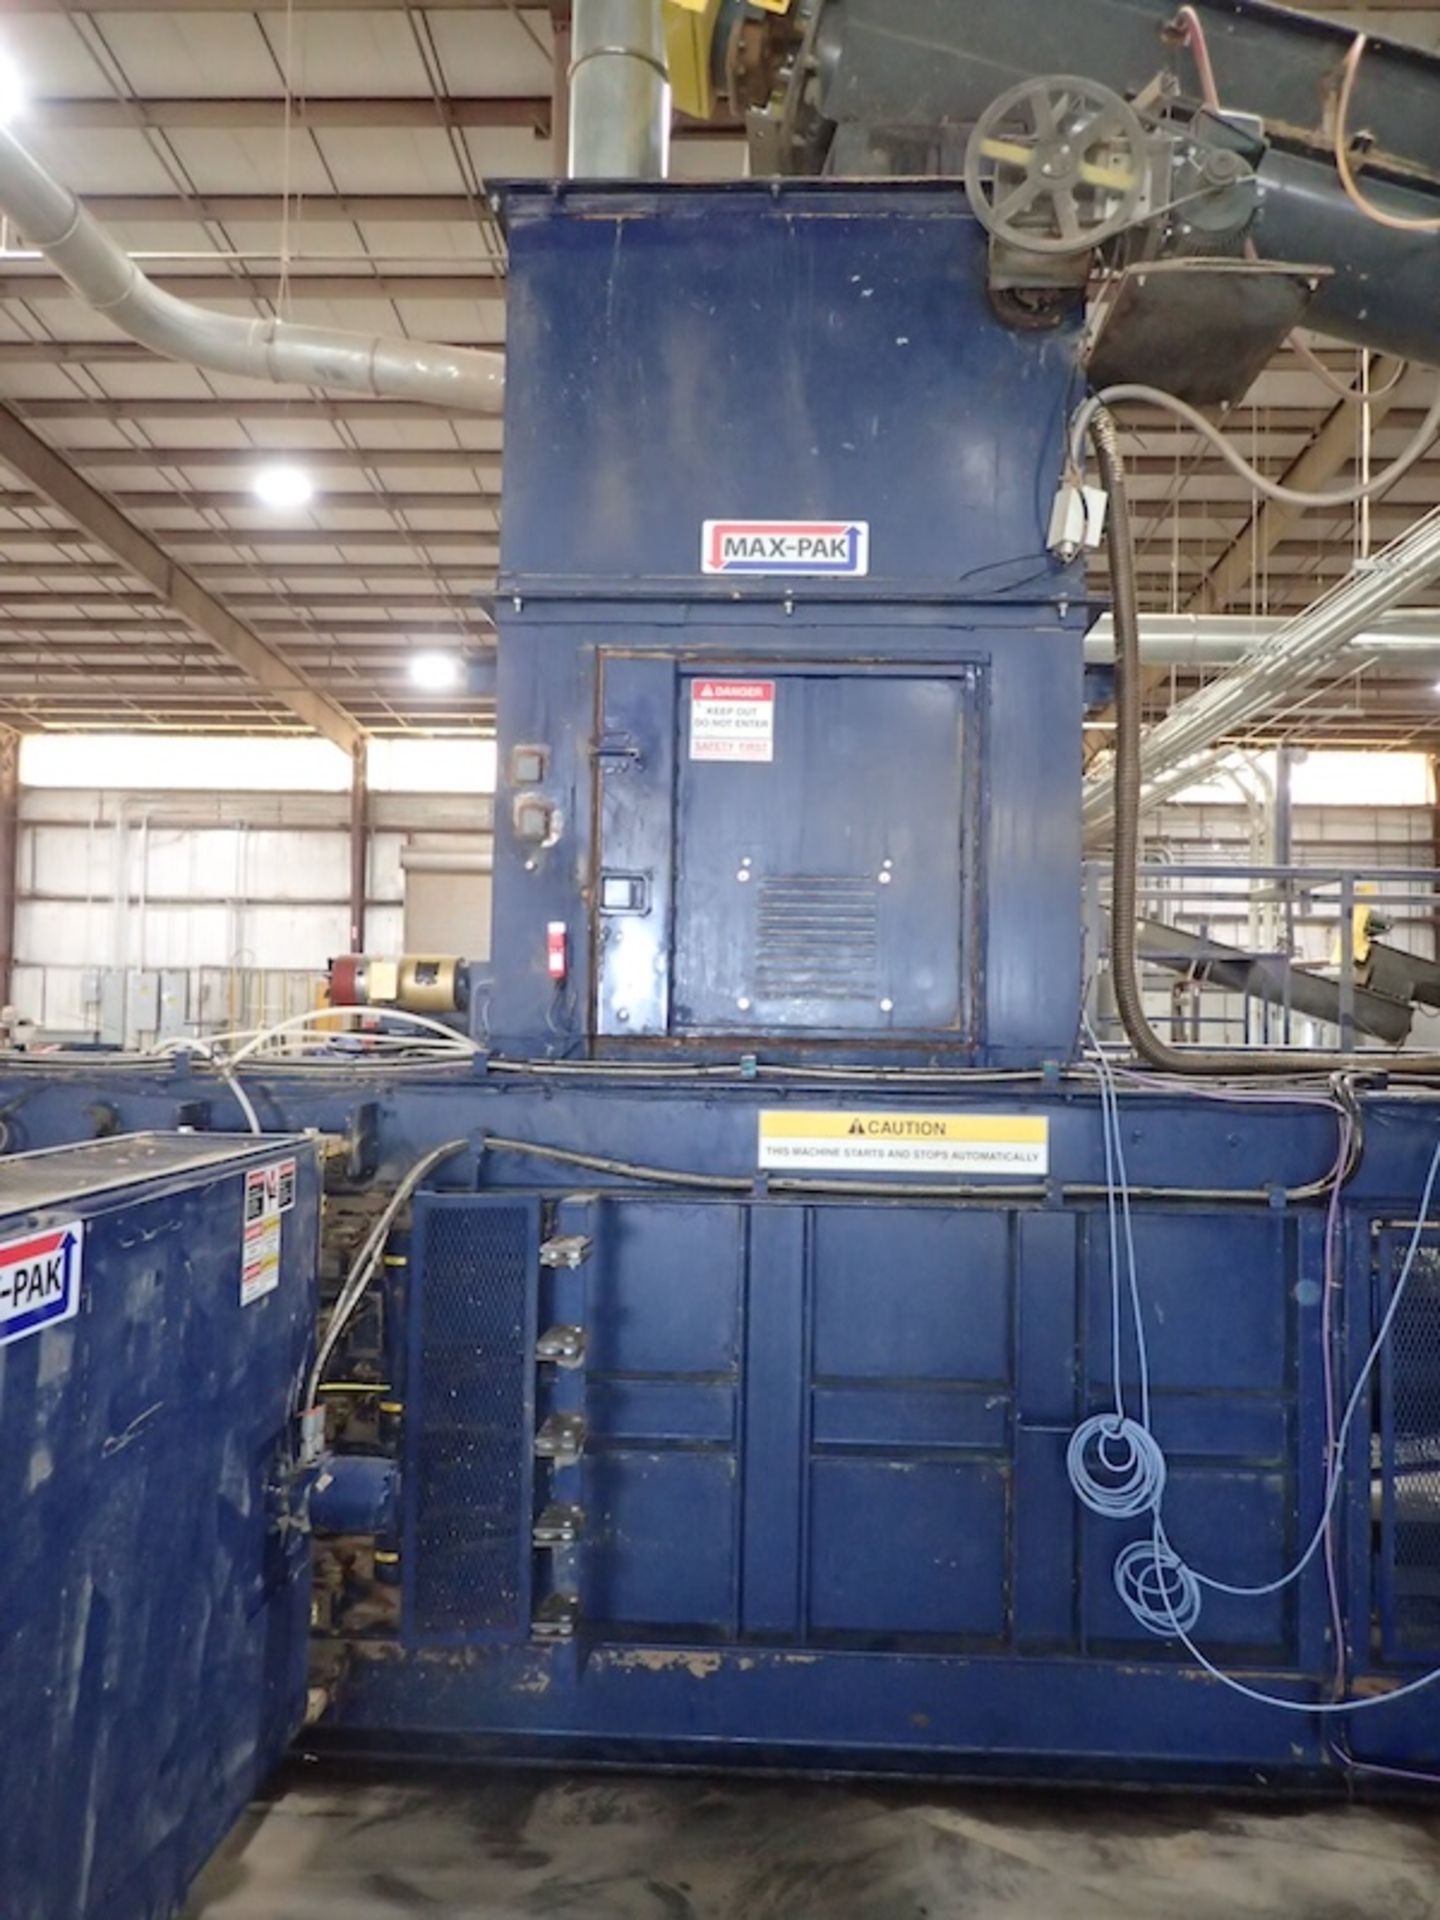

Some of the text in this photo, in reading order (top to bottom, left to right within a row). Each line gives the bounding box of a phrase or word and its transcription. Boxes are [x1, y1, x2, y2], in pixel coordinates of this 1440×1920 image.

[724, 537, 847, 559] MAX-PAK
[714, 686, 765, 697] DANGER
[706, 707, 758, 717] KEEP OUT
[694, 717, 769, 729] DO NOT ENTER
[694, 741, 769, 753] SAFETY FIRST
[867, 1119, 946, 1136] CAUTION
[766, 1146, 1040, 1163] THIS MACHINE STARTS AND STOPS AUTOMATICALLY
[0, 1255, 62, 1308] -PAK
